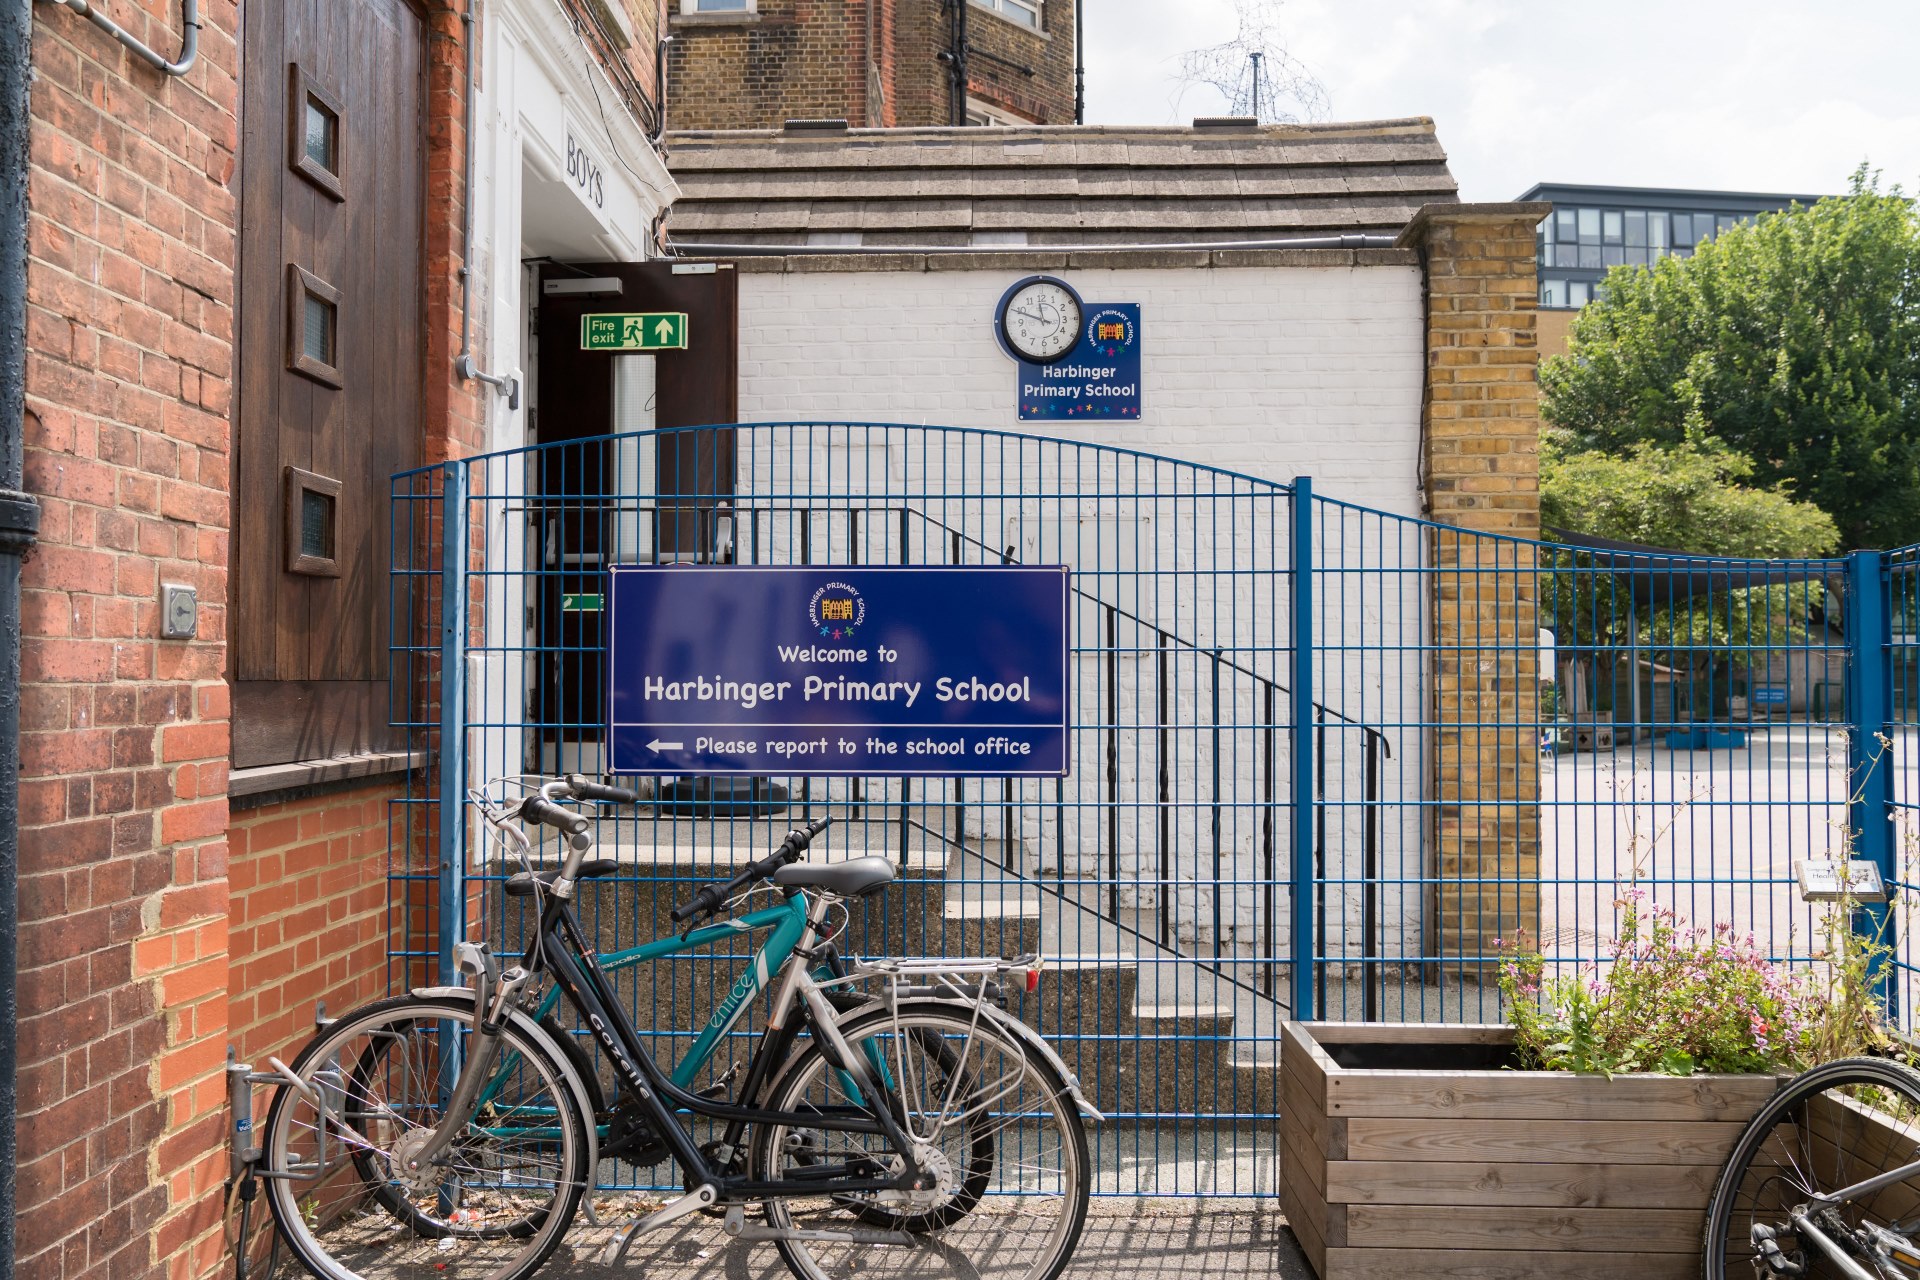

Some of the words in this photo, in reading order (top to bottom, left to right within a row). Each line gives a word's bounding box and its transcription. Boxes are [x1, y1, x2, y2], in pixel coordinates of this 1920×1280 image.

[567, 131, 603, 209] BOYS
[1026, 297, 1034, 305] 11
[1017, 306, 1027, 315] 10
[592, 320, 615, 331] Fire
[1018, 319, 1023, 327] 9
[1088, 313, 1102, 347] HARBINGER
[1101, 310, 1129, 321] PRIMARY
[1124, 321, 1134, 346] SCHOOL
[592, 333, 615, 343] exit
[1021, 329, 1027, 337] 8
[1053, 336, 1059, 344] 5
[1029, 338, 1036, 346] 7
[1041, 339, 1047, 347] 6
[1043, 365, 1117, 379] Harbinger
[1024, 384, 1081, 398] Primary
[1085, 383, 1135, 397] School
[809, 587, 826, 628] HARBINGER
[826, 582, 860, 597] PRIMARY
[854, 597, 865, 626] SCHOOL
[778, 645, 868, 663] Welcome
[878, 645, 898, 663] to
[644, 675, 792, 709] Harbinger
[803, 675, 921, 708] Primary
[935, 675, 1031, 702] School
[696, 737, 757, 754] Please
[766, 737, 829, 759] report
[838, 737, 857, 754] to
[866, 737, 898, 755] the
[905, 737, 965, 755] school
[974, 736, 1031, 755] office
[601, 954, 642, 970] apollo
[710, 974, 754, 1028] entice
[590, 1013, 651, 1100] Gazelle
